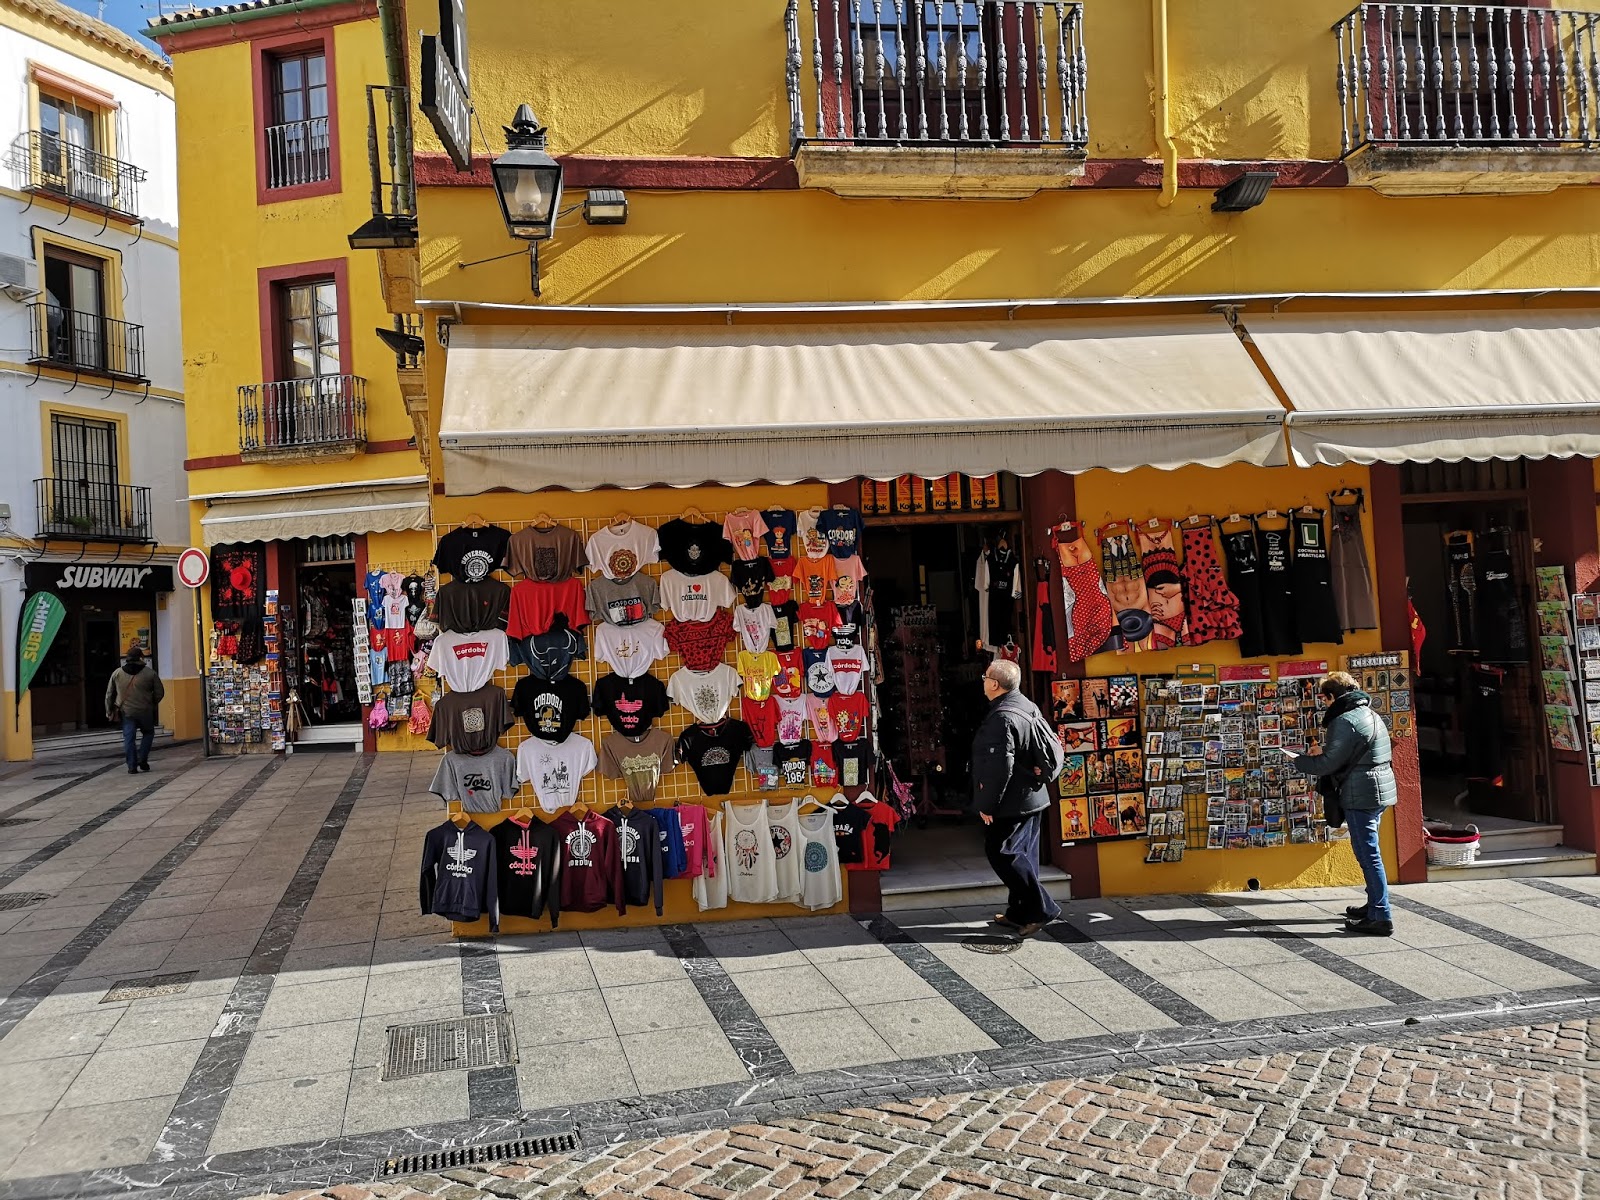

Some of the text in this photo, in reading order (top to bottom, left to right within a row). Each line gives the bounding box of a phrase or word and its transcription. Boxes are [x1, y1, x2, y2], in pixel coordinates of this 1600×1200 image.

[864, 503, 887, 511] Koak
[900, 502, 922, 510] Koak
[461, 549, 494, 565] UNIVERSIDAD
[56, 566, 153, 589] SUBWAY
[24, 596, 52, 663] SUBWAY
[534, 692, 562, 713] CORDOBA
[464, 773, 492, 790] Toro
[833, 824, 854, 834] SPAÑA
